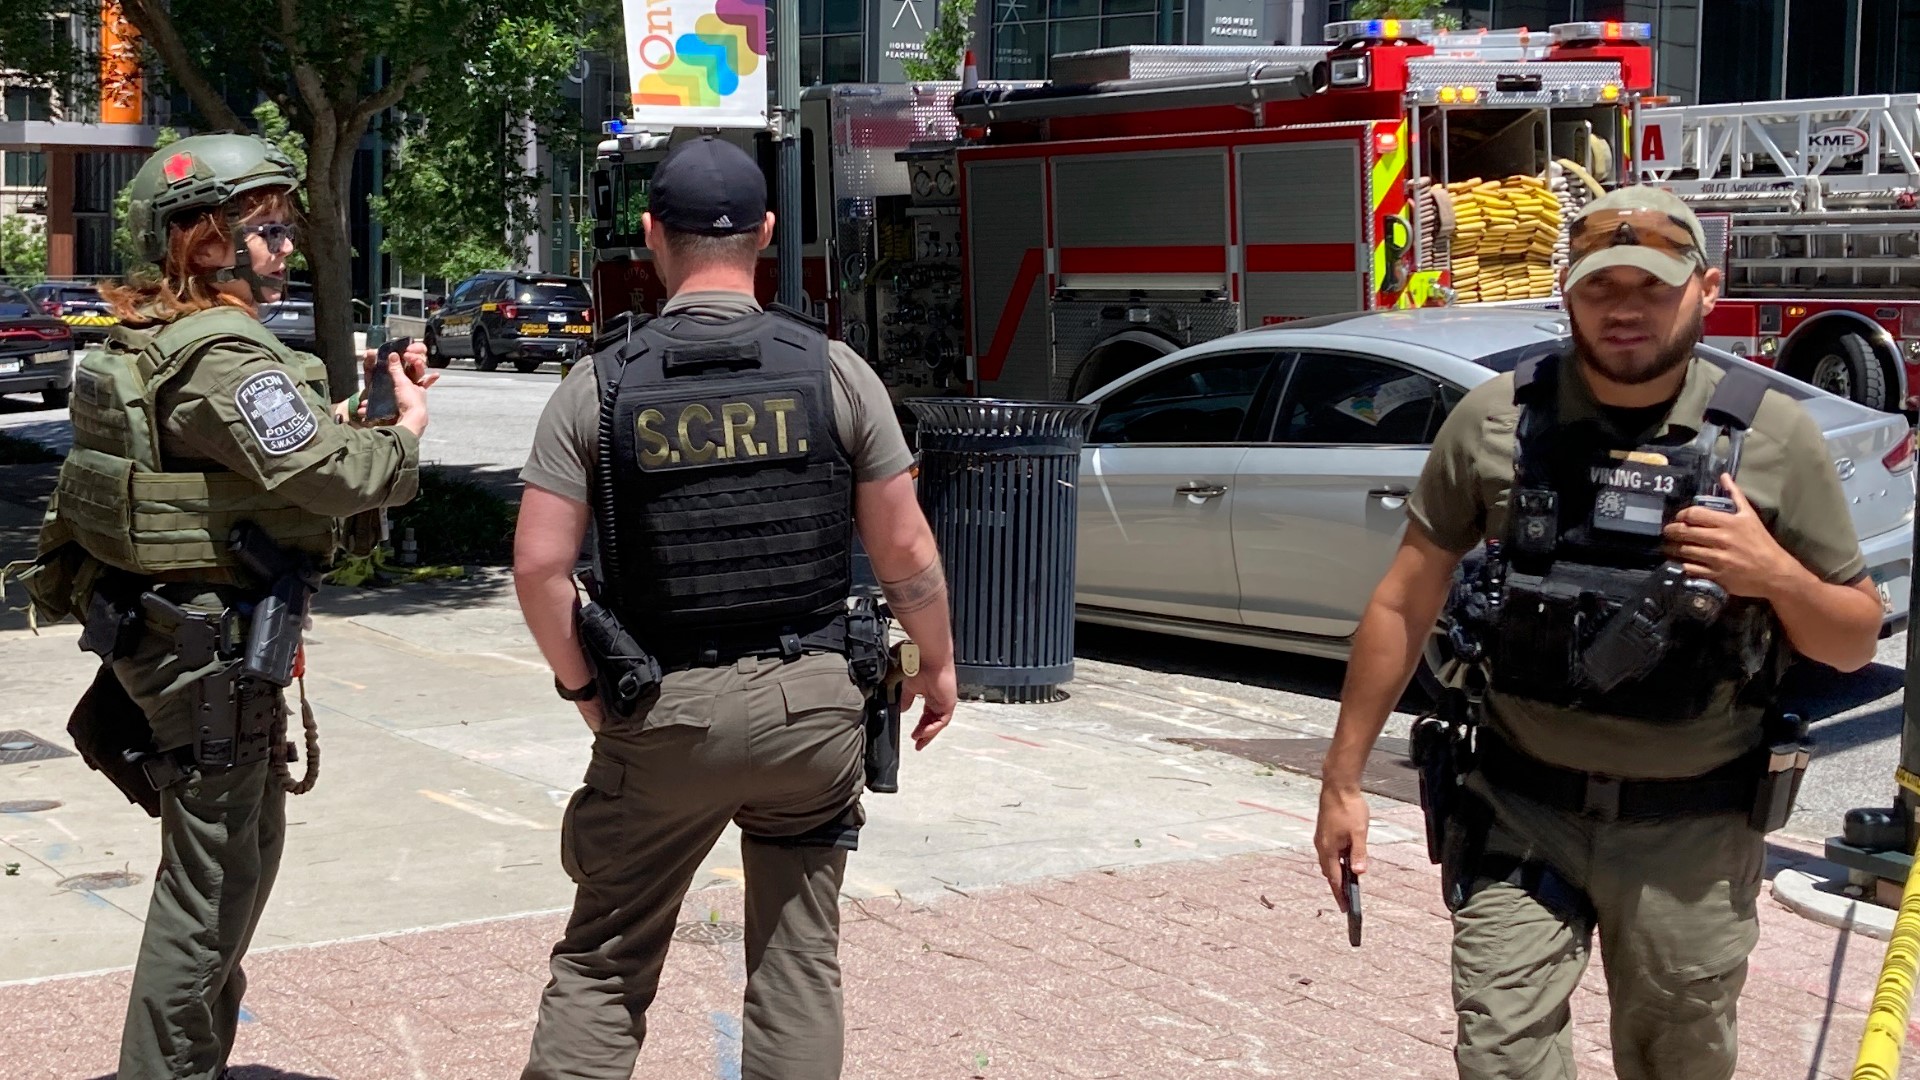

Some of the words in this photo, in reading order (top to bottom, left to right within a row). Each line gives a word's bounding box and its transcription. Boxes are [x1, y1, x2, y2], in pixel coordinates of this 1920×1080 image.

[1211, 27, 1258, 37] PEACHTREE
[1232, 17, 1254, 26] WEST
[640, 0, 676, 71] On
[885, 51, 928, 60] PEACHTREE
[1808, 134, 1856, 147] KME
[241, 375, 284, 403] FULTON
[266, 412, 305, 438] POLICE
[297, 421, 314, 440] TEAM
[637, 398, 807, 467] S.C.R.T.
[1589, 466, 1642, 489] VIKING
[1652, 474, 1675, 494] 13
